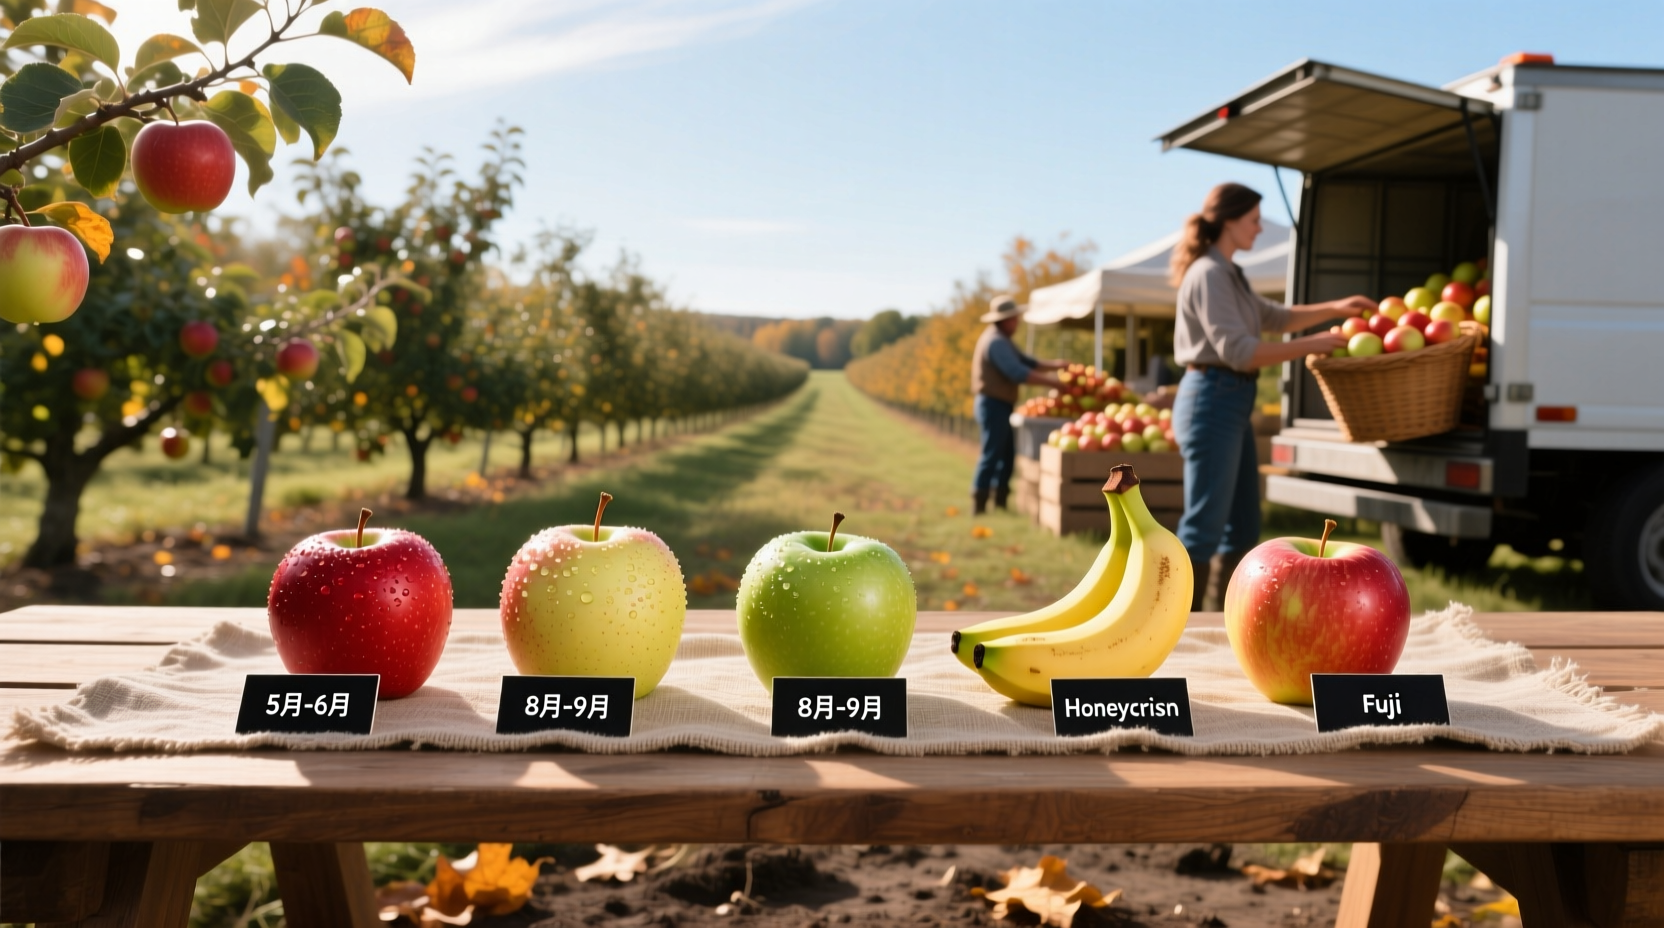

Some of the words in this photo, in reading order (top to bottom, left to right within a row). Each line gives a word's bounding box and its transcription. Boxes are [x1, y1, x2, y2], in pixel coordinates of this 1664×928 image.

[265, 692, 350, 718] 5月-6月
[524, 693, 609, 720] 8月-9月
[797, 695, 881, 721] 8月-9月
[1064, 696, 1179, 723] Honeycrisn
[1362, 692, 1402, 720] Fuji
